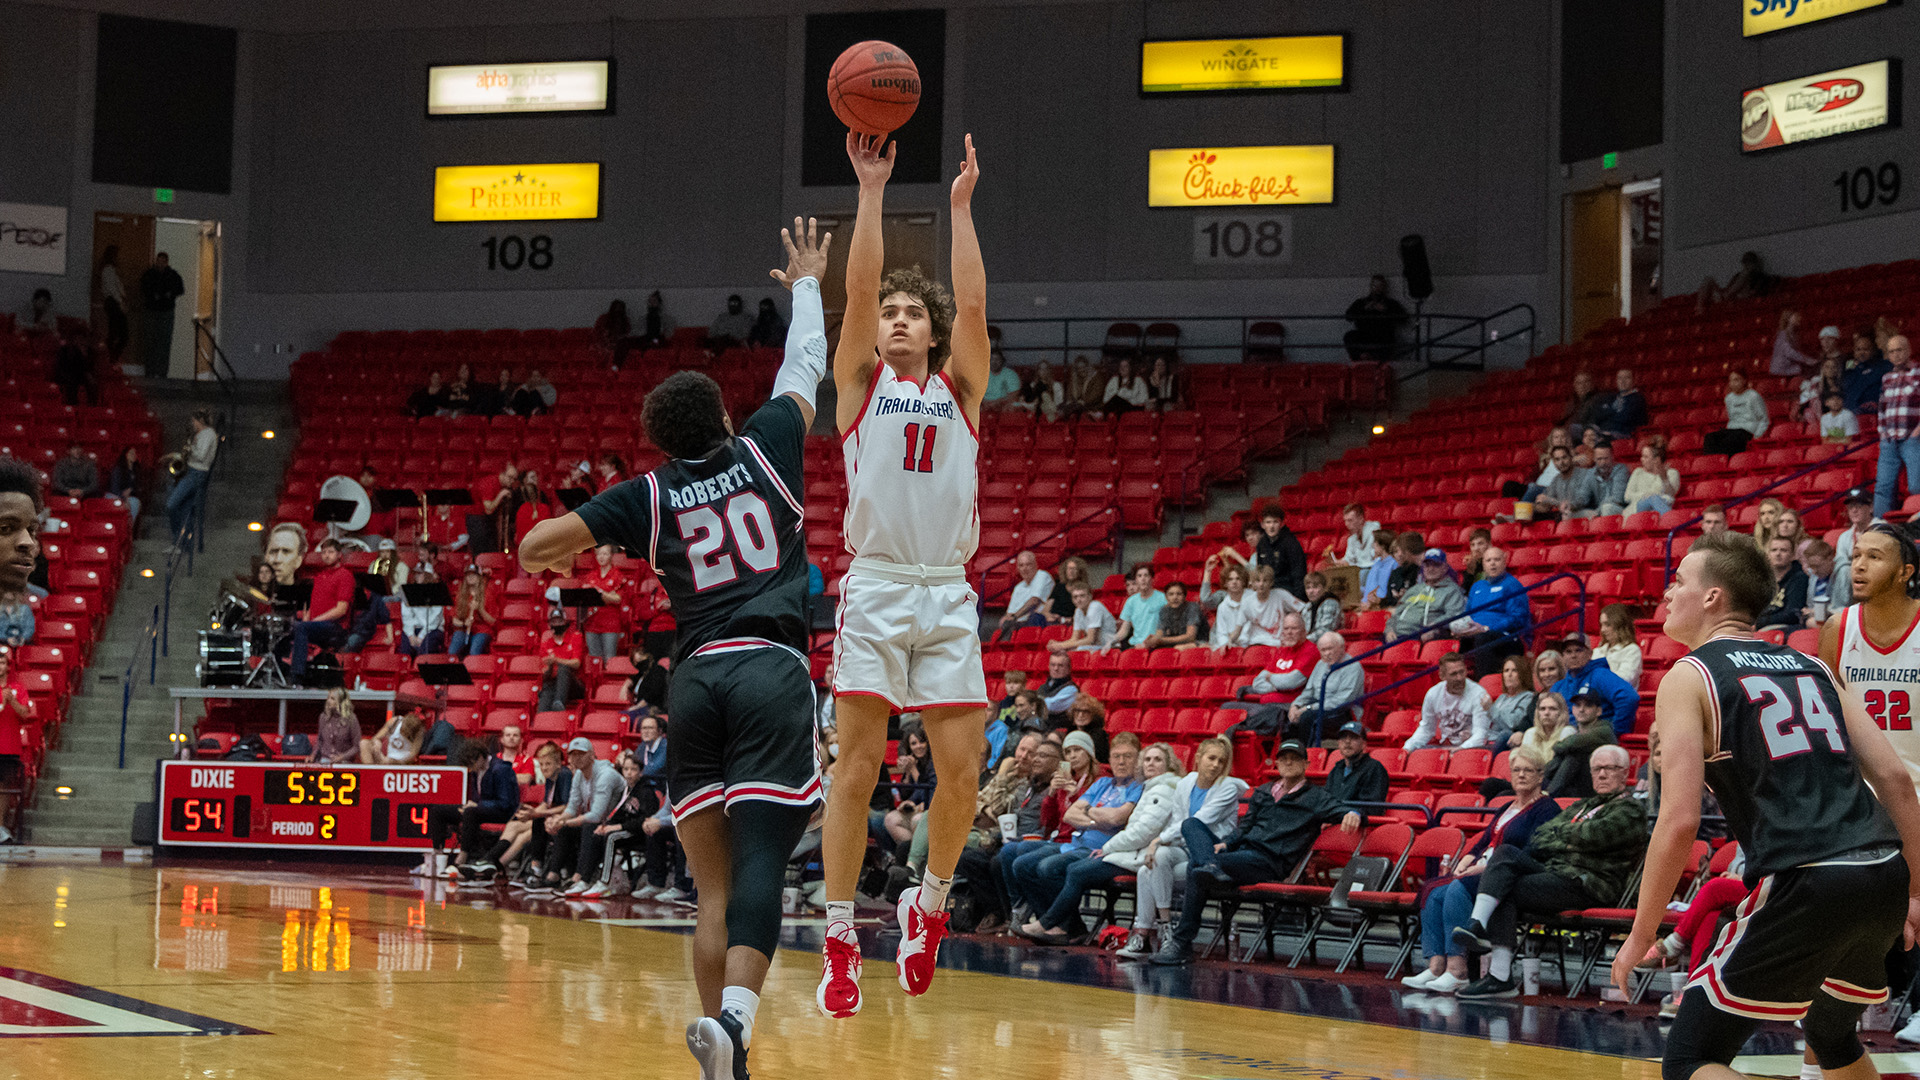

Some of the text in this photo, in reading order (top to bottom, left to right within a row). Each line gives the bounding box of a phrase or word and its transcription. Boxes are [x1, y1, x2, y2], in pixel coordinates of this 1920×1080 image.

[476, 69, 557, 91] alphagraphics
[1201, 57, 1279, 71] WINGATE
[871, 78, 919, 95] Wilson
[1785, 83, 1860, 112] MegaPro
[1183, 162, 1299, 203] Chick-fil-A
[1833, 161, 1900, 212] 109
[481, 234, 554, 271] 108
[1201, 220, 1284, 258] 108
[903, 421, 937, 473] 11
[668, 462, 753, 509] ROBERTS
[674, 489, 780, 593] 20
[1737, 674, 1846, 761] 24
[1864, 689, 1913, 731] 22
[190, 768, 235, 789] DIXIE
[287, 771, 357, 805] 5:52
[383, 772, 441, 793] GUEST
[184, 800, 222, 831] 54
[272, 815, 335, 839] PERIOD 2
[410, 806, 428, 835] 4
